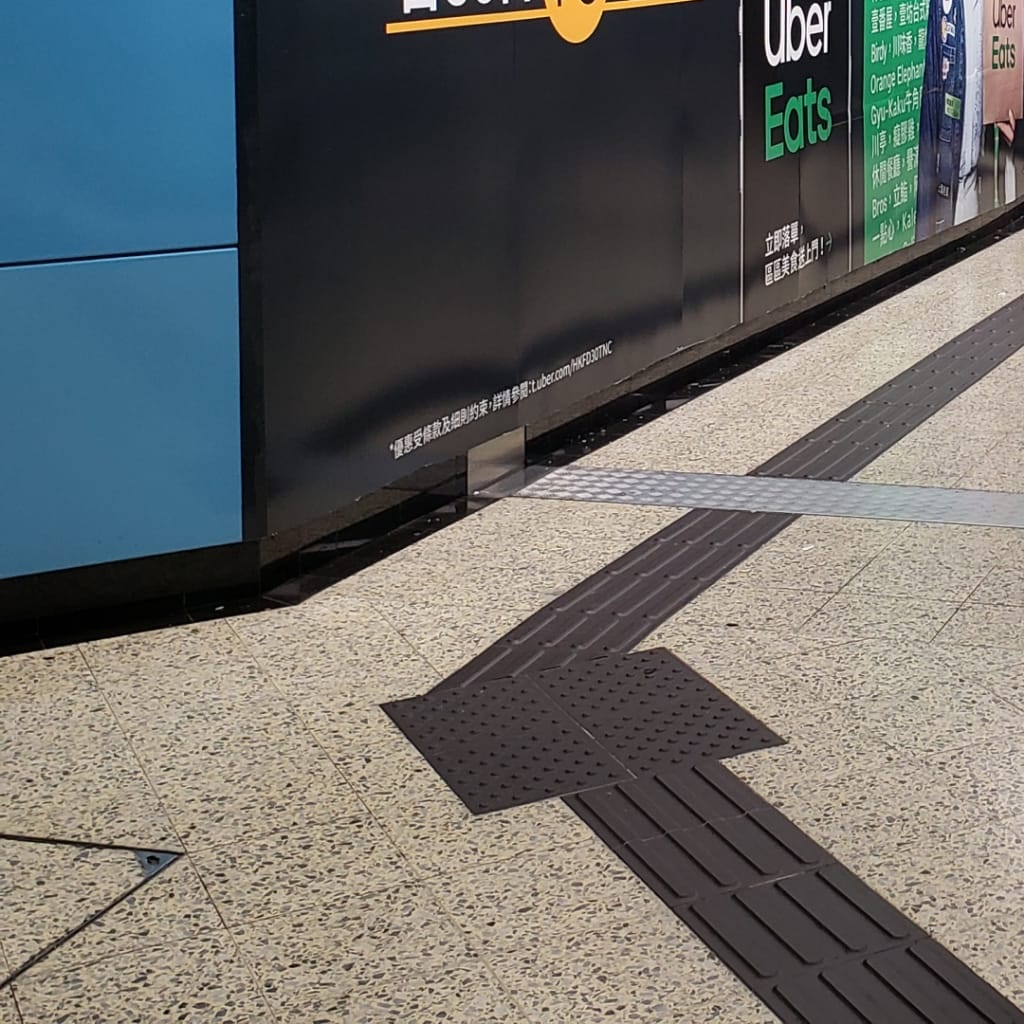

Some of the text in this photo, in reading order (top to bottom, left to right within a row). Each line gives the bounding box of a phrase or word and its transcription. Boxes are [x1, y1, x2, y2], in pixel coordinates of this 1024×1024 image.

[992, 35, 1016, 70] Eats
[870, 72, 896, 94] Orange
[764, 78, 832, 161] Eats
